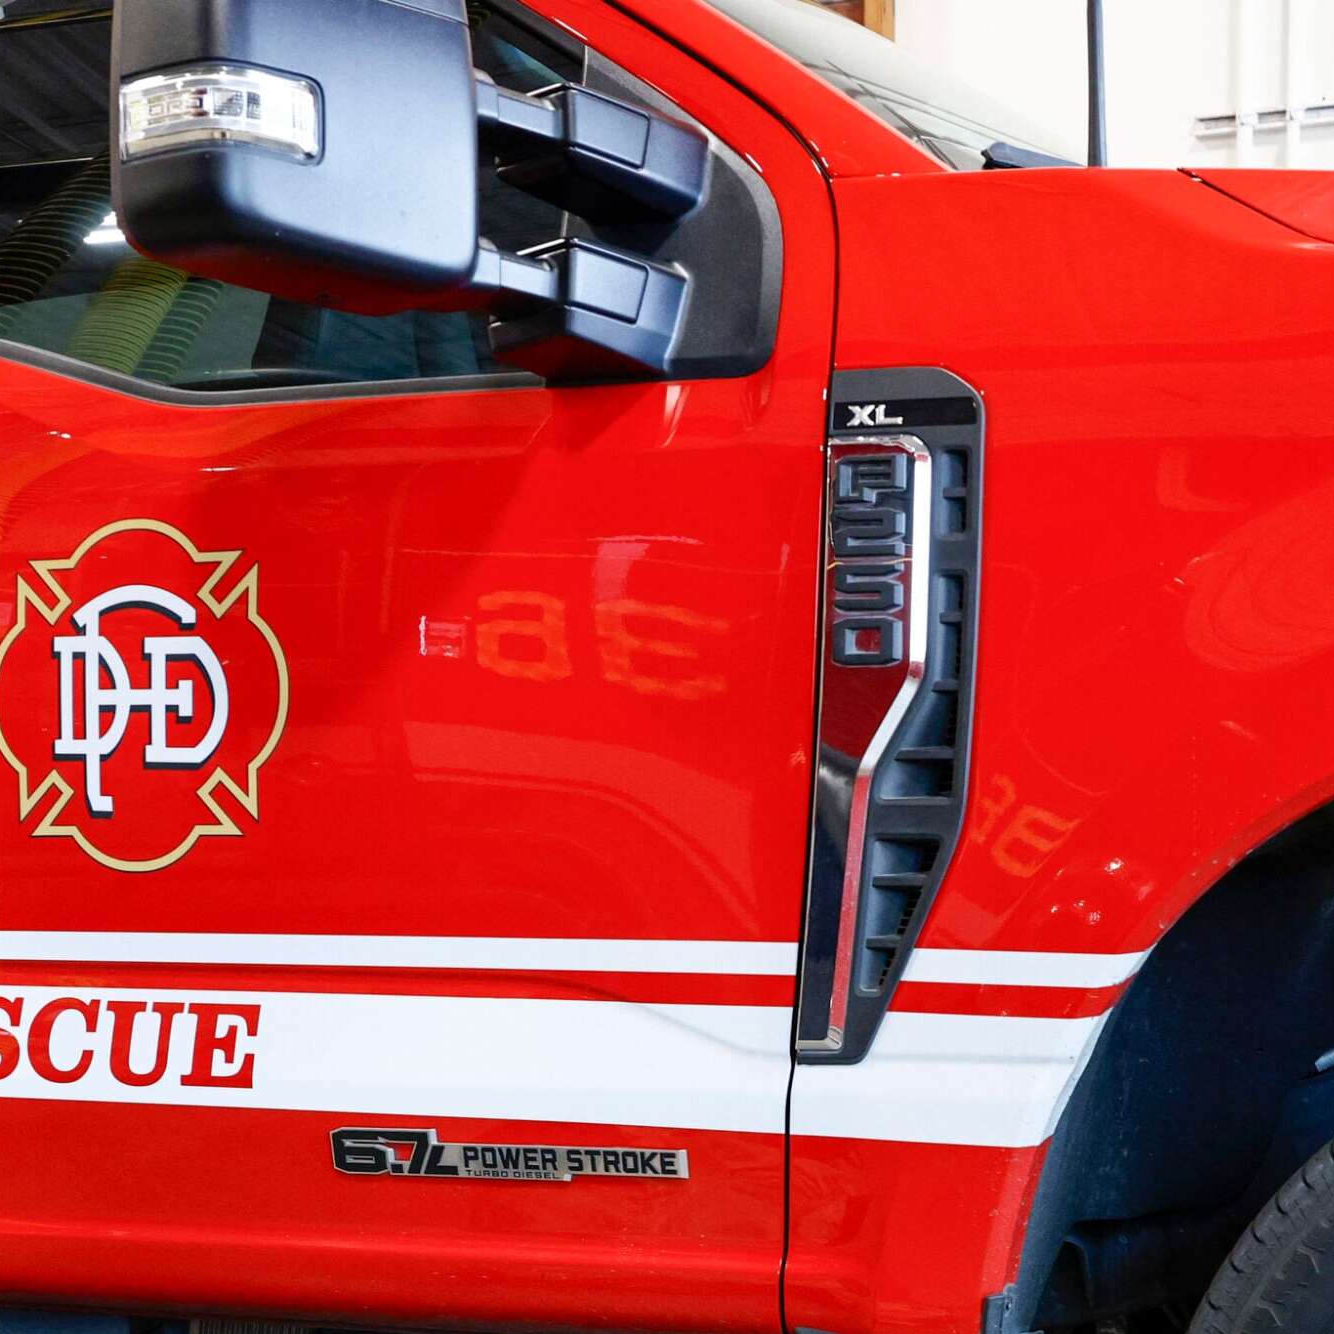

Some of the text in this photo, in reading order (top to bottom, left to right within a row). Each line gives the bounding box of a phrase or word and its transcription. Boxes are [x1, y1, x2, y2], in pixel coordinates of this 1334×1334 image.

[846, 404, 904, 427] XL
[330, 1127, 678, 1176] 6.7L POWER STROKE
[465, 1169, 509, 1178] TURBO
